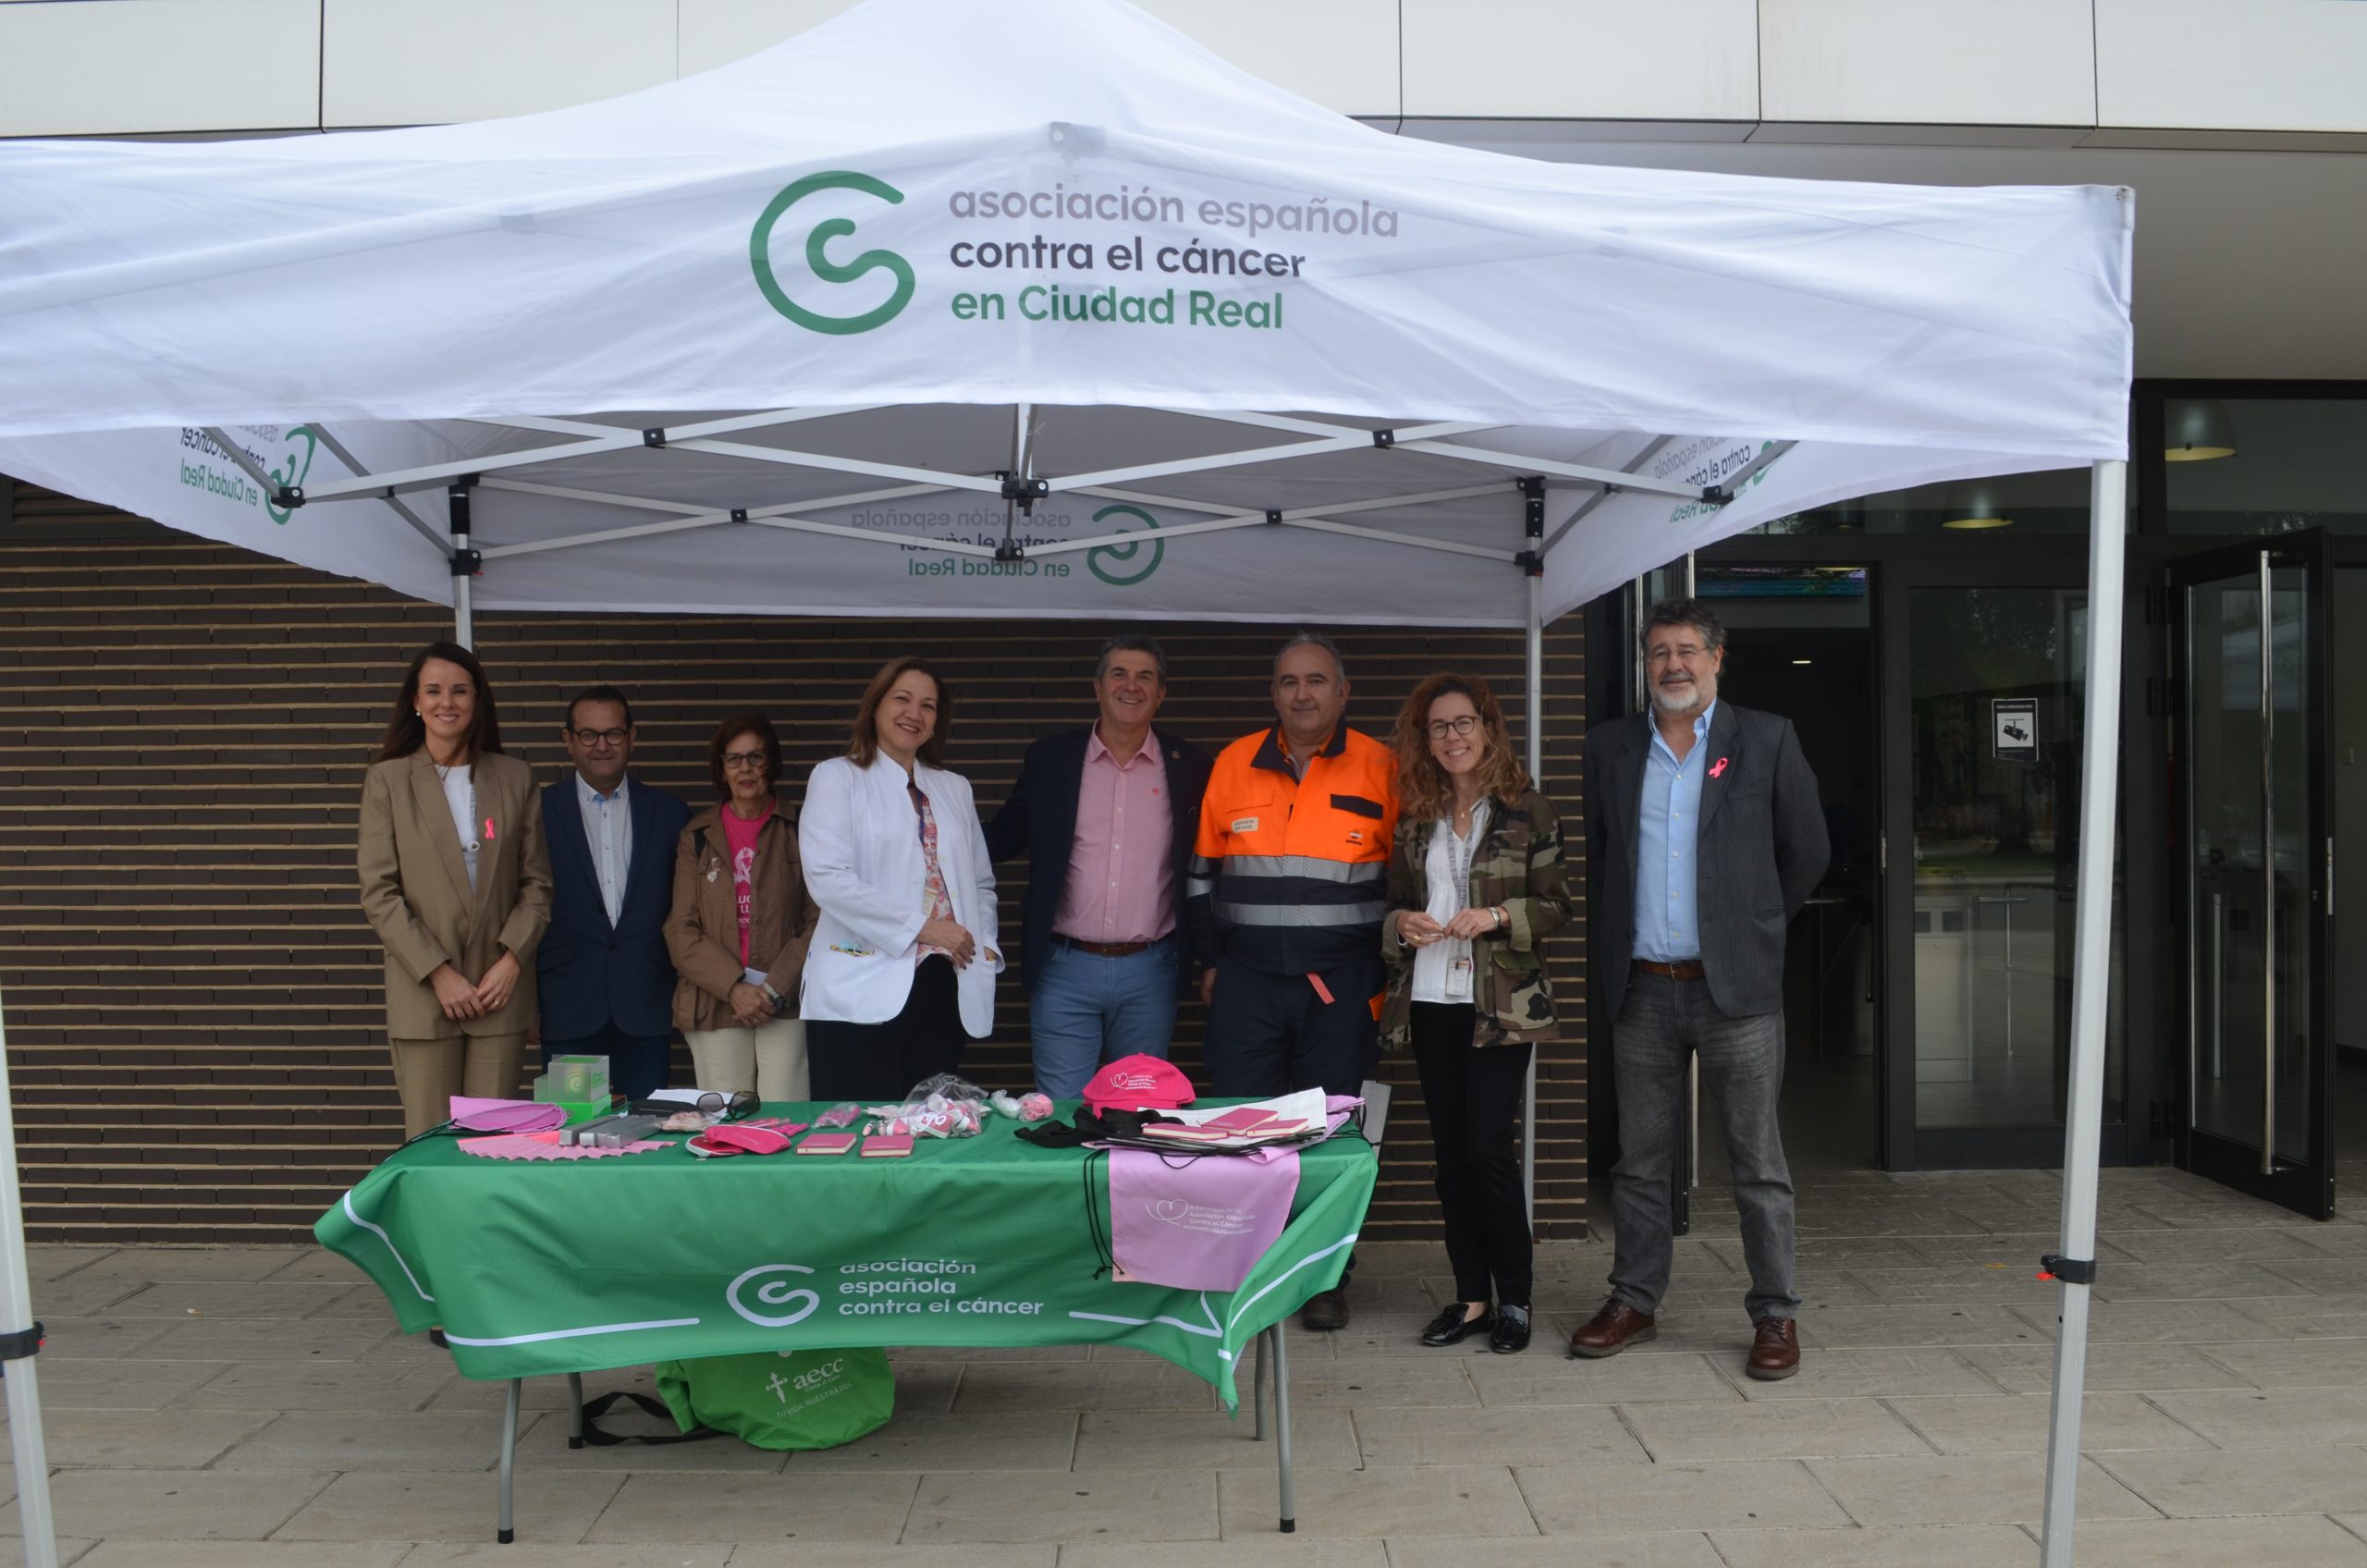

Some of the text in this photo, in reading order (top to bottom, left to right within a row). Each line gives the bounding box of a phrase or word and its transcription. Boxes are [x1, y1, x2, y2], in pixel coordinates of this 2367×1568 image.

[949, 184, 1399, 239] asociación española
[950, 235, 1306, 278] contra el cáncer
[950, 285, 1284, 330] en Ciudad Real
[839, 1257, 976, 1275] asociación
[839, 1277, 957, 1297] española
[839, 1296, 1045, 1317] contra el cáncer
[793, 1358, 844, 1390] aecc
